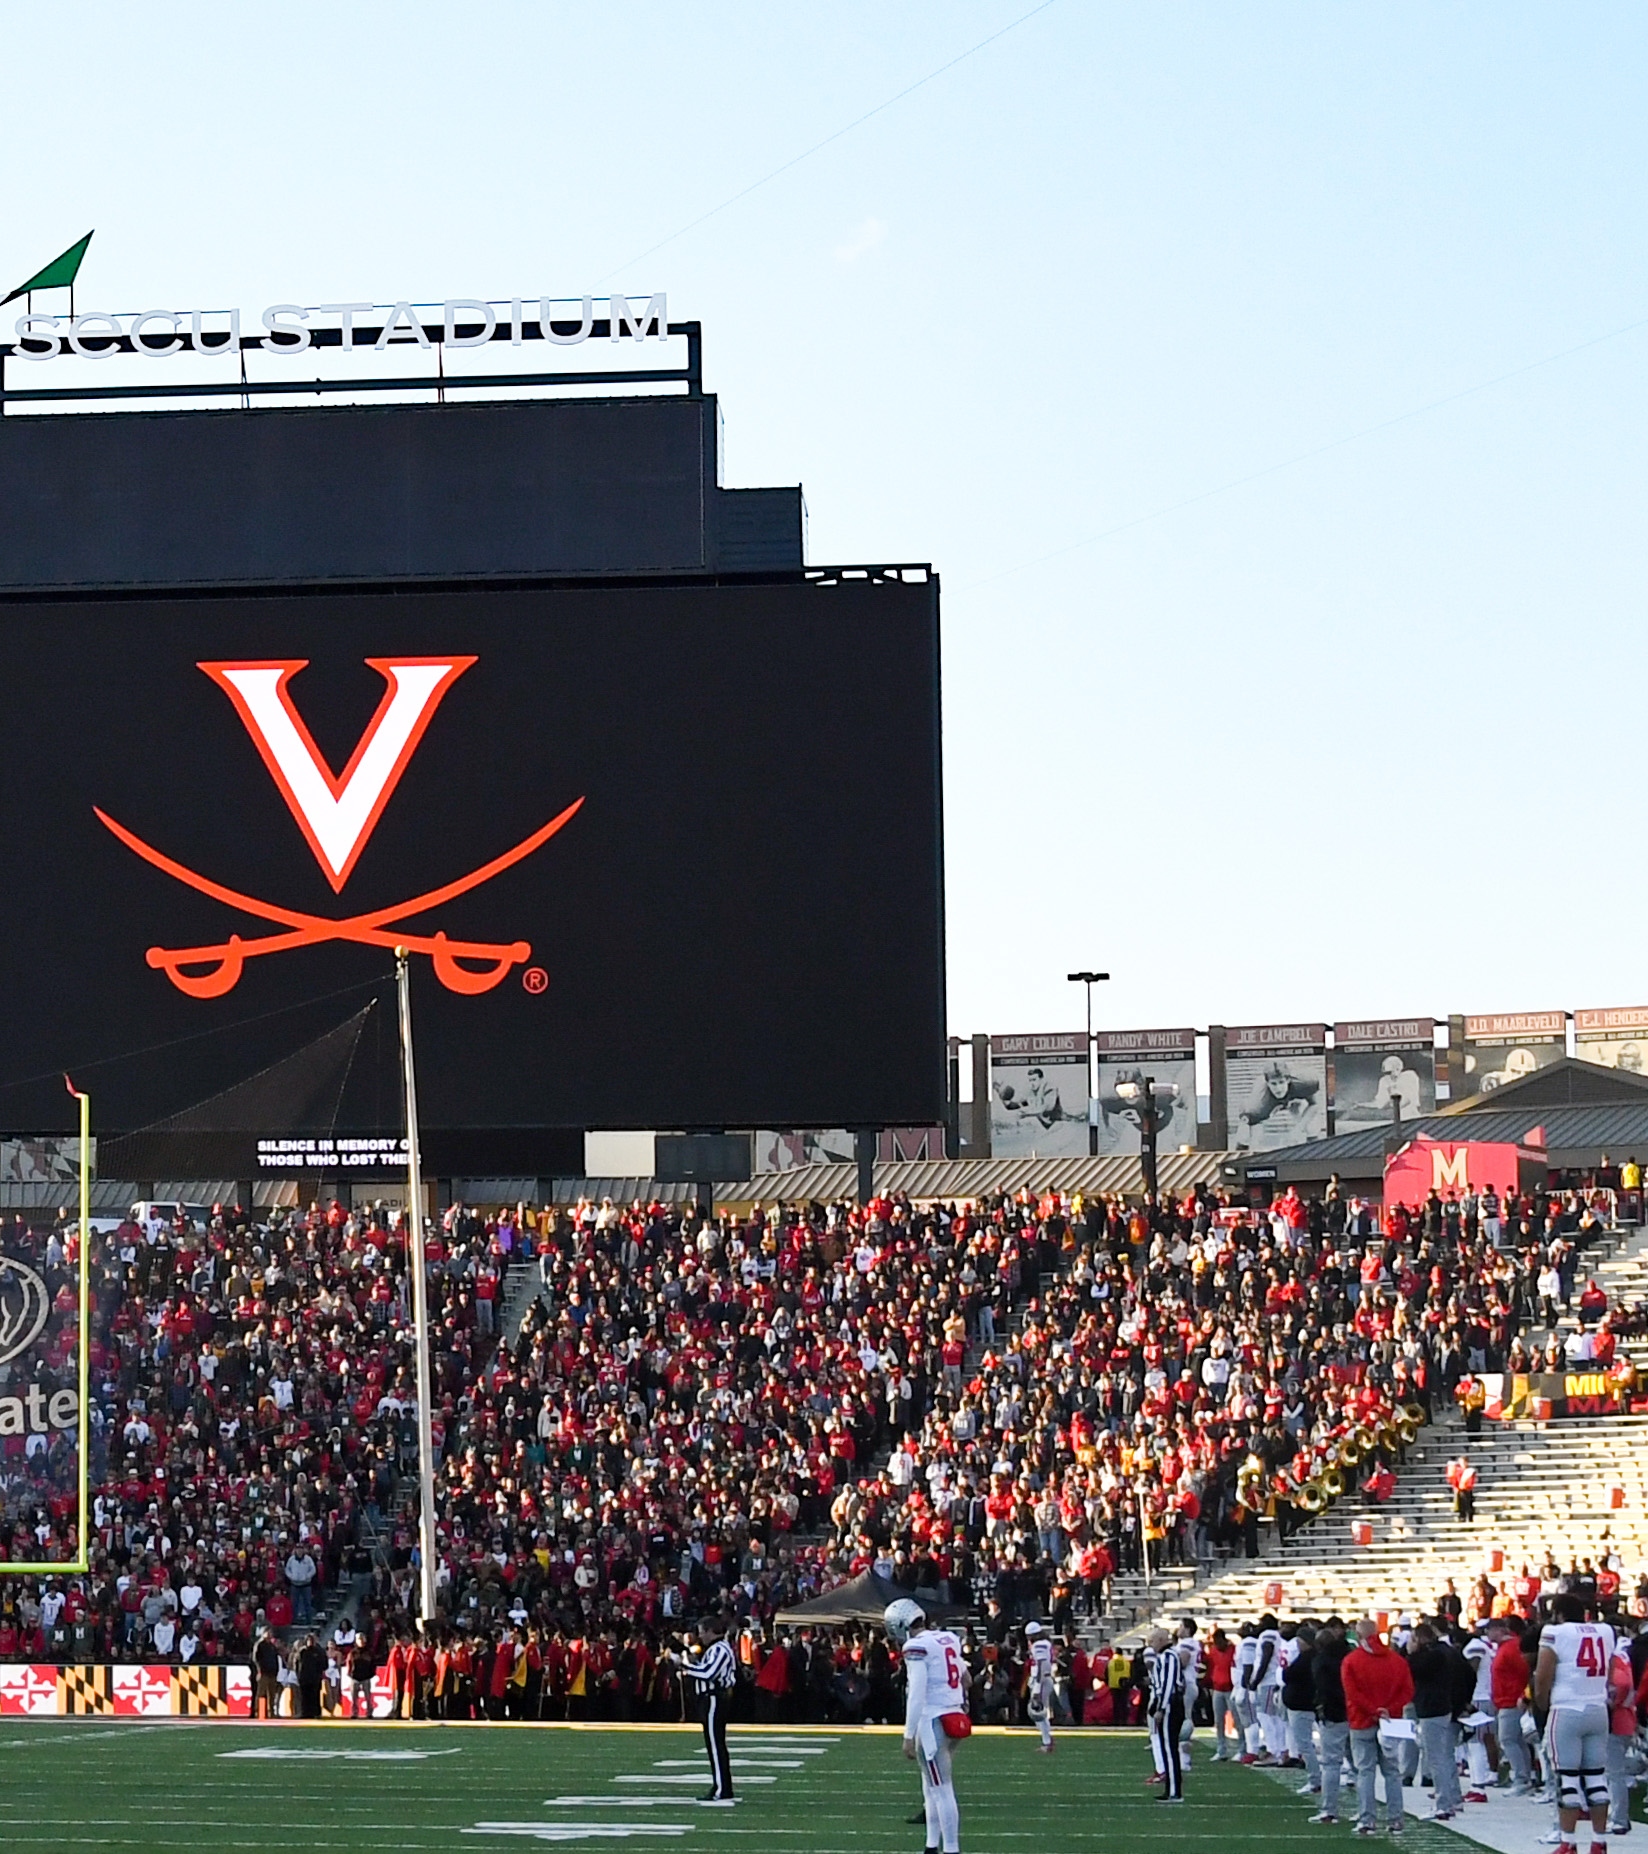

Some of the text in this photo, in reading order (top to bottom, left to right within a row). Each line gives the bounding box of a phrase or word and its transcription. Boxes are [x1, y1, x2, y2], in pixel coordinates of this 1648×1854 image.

[259, 293, 668, 354] STADIUM
[196, 656, 479, 894] V
[1237, 1027, 1312, 1043] JOE CAMPBELL
[1347, 1022, 1418, 1038] DALE CASTRO
[1001, 1036, 1075, 1051] GARY COLLINS
[1108, 1032, 1182, 1048] RANDY WHITE
[257, 1139, 316, 1152] SILENCE
[318, 1139, 334, 1151] IN
[336, 1139, 397, 1151] MEMORY
[257, 1154, 304, 1166] THOSE
[306, 1154, 339, 1166] WHO
[341, 1154, 377, 1165] LOST
[1430, 1147, 1469, 1191] M
[1576, 1636, 1606, 1677] 41
[945, 1646, 960, 1690] 6
